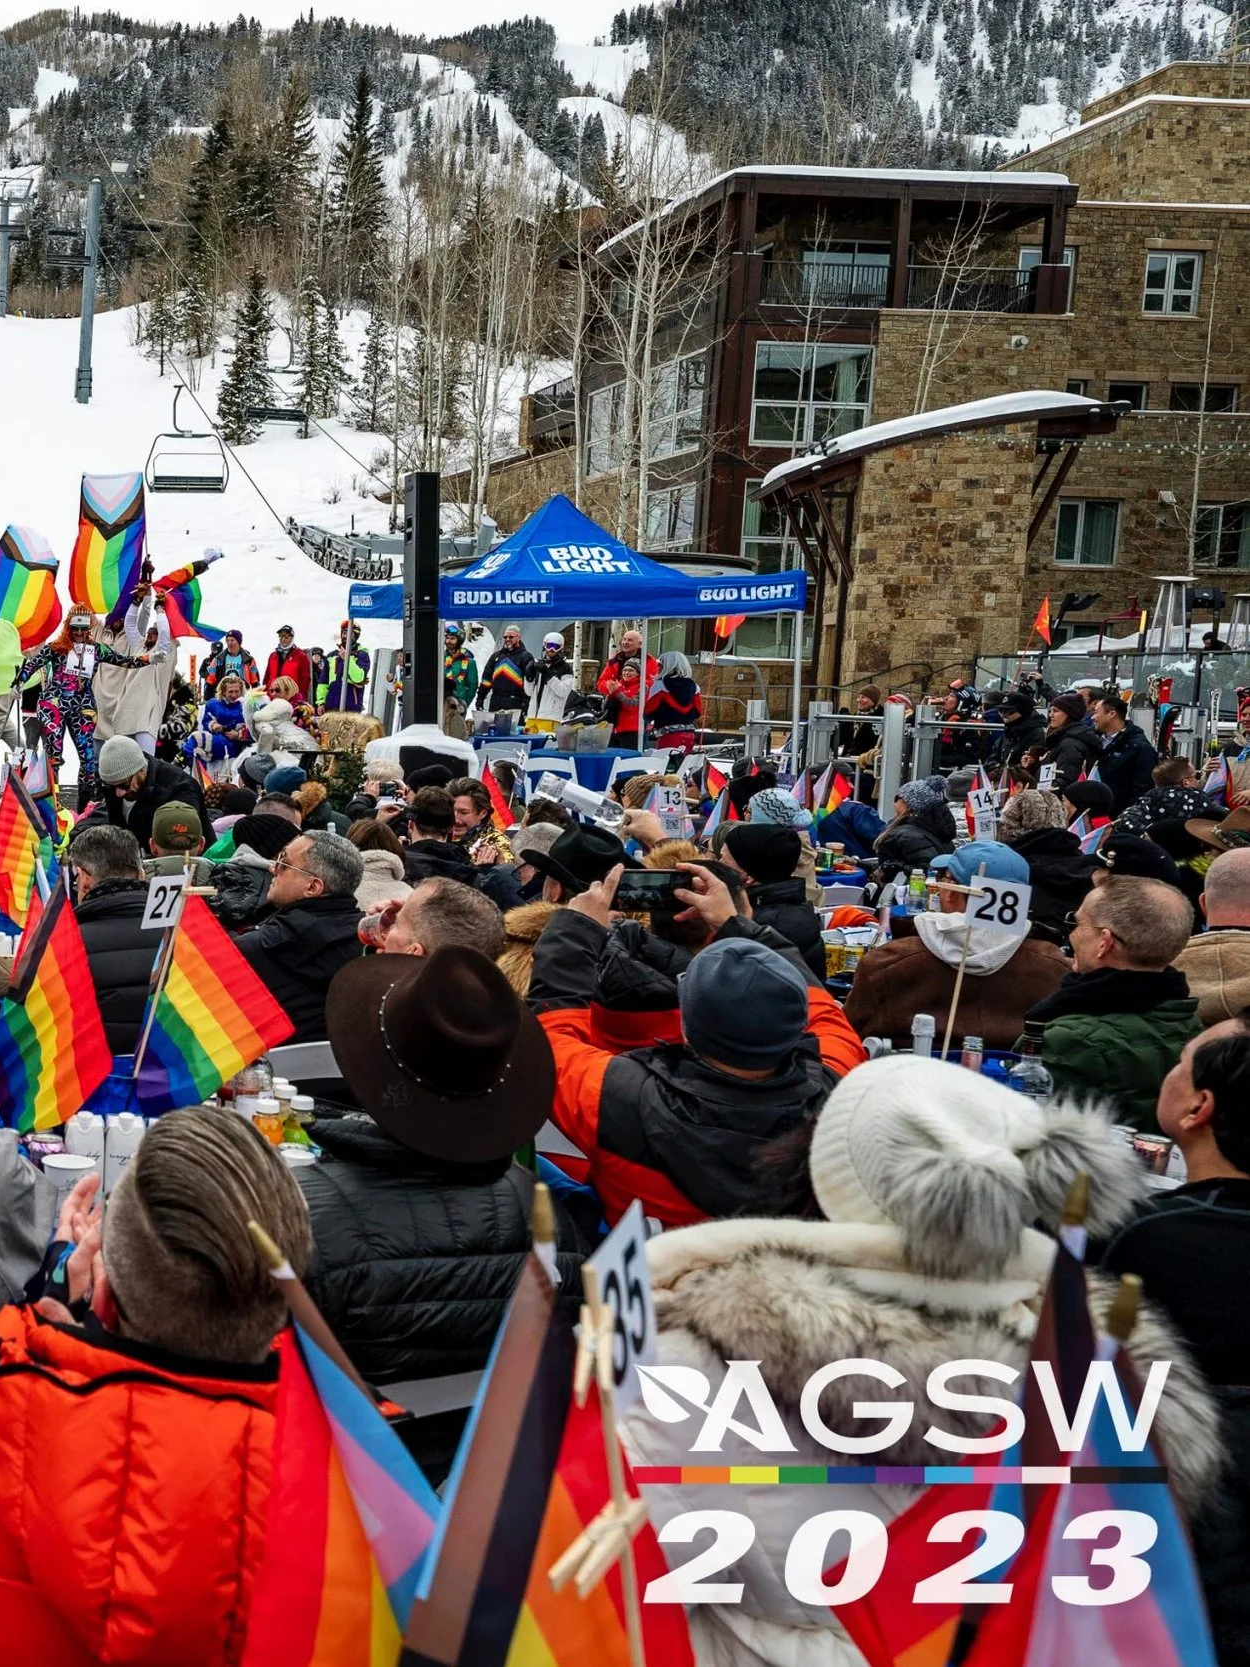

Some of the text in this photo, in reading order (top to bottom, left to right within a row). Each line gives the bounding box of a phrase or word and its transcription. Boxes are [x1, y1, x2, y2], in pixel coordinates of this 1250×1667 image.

[547, 545, 613, 561] BUD
[541, 559, 634, 573] LIGHT
[453, 590, 549, 605] BUD LIGHT
[700, 584, 795, 602] BUD LIGHT
[1045, 767, 1052, 779] 7
[664, 790, 681, 805] 13
[973, 790, 993, 808] 14
[149, 885, 183, 919] 27
[974, 886, 1019, 925] 28
[604, 1237, 647, 1387] 35
